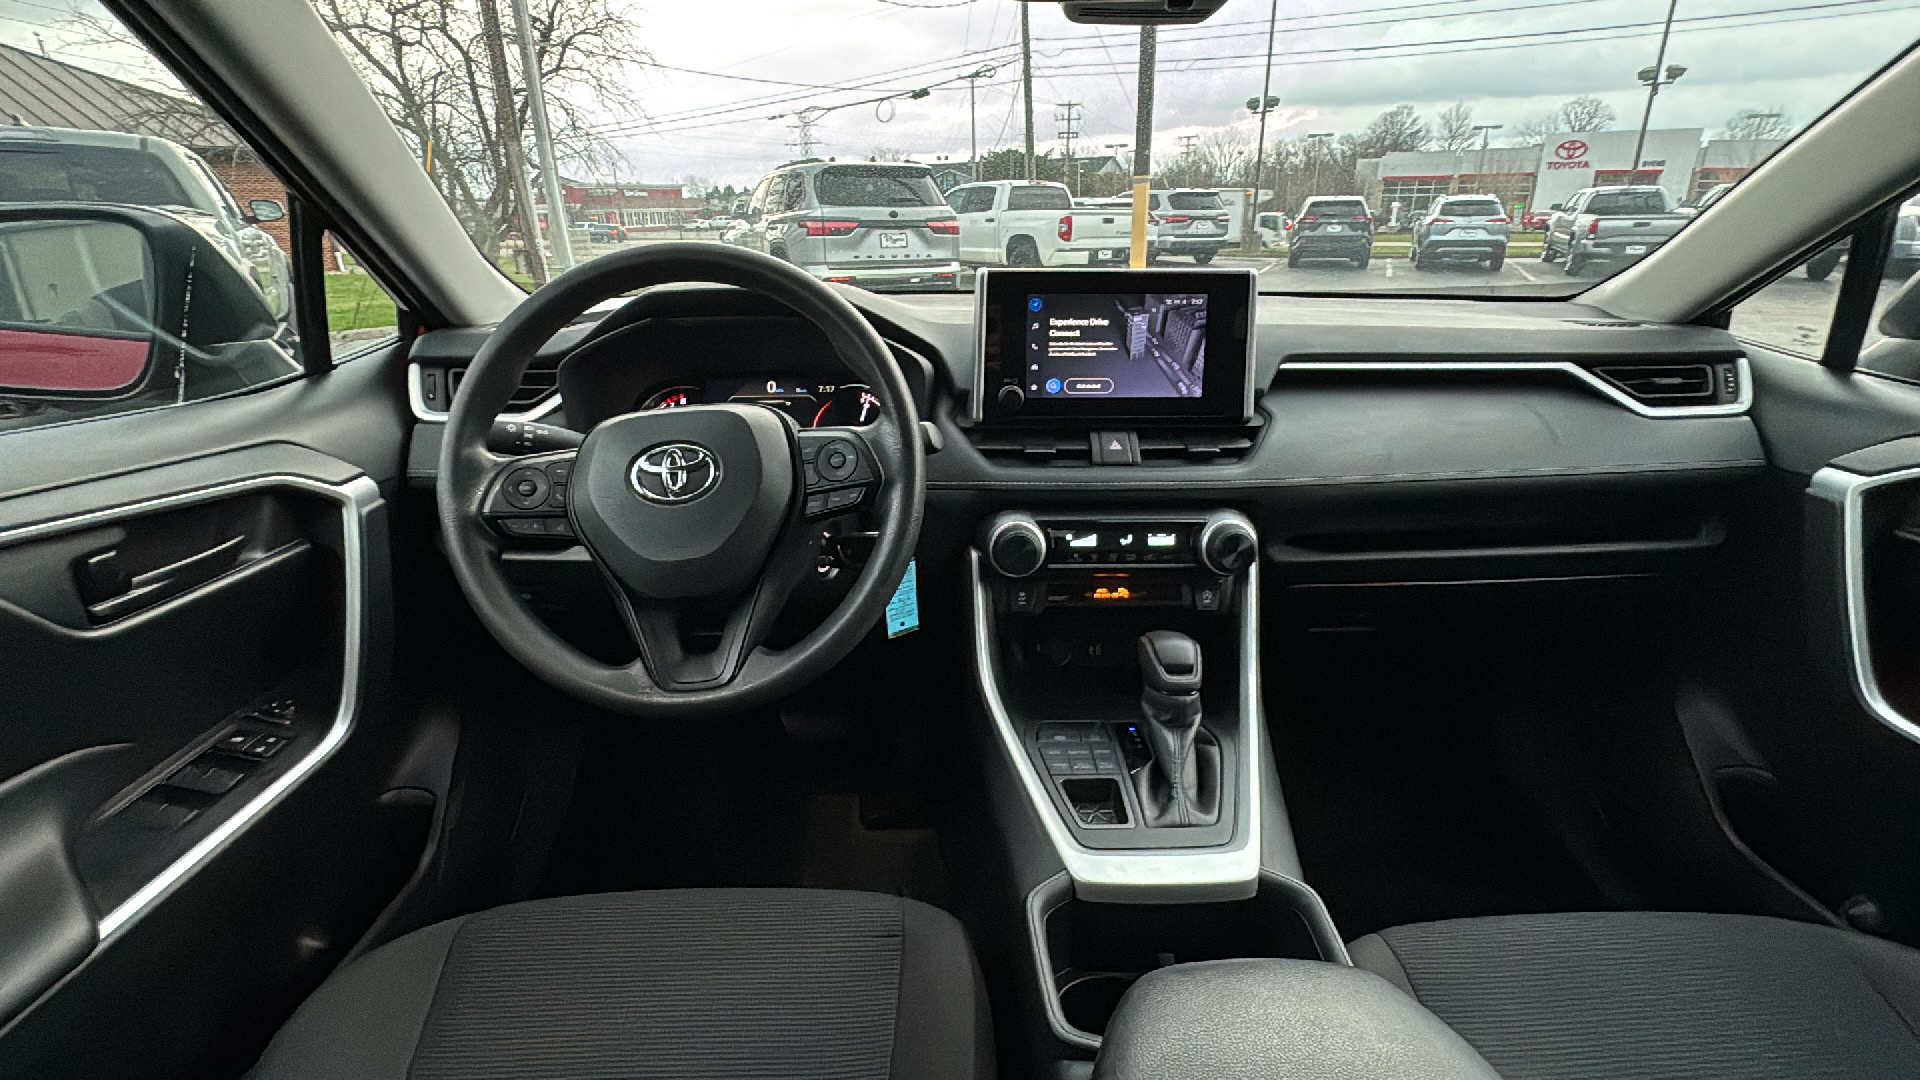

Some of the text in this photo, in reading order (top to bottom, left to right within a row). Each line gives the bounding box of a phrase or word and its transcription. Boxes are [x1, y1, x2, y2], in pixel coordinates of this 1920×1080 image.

[1546, 160, 1590, 170] TOYOTA
[1049, 317, 1110, 327] Experience Drive
[766, 380, 777, 393] 0
[817, 385, 835, 393] 7:17
